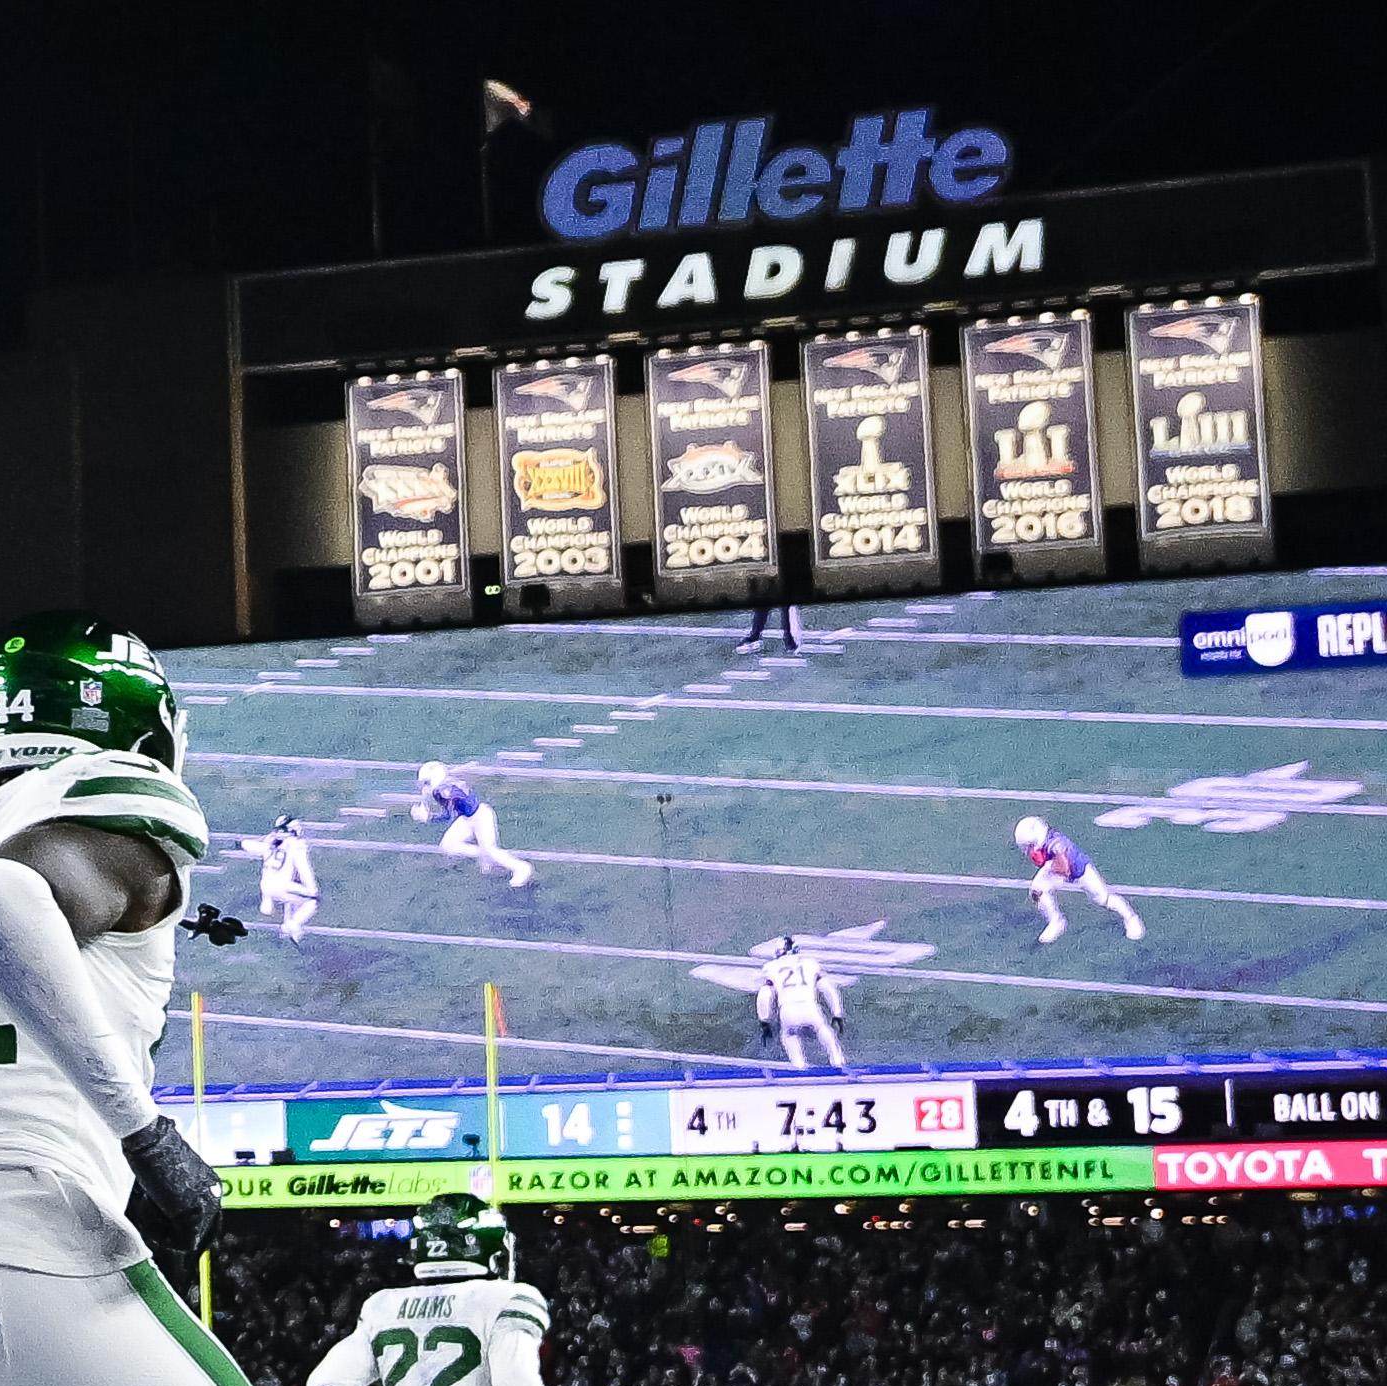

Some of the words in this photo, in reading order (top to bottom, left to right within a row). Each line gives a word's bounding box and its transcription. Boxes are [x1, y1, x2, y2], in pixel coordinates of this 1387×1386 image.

[542, 109, 1008, 240] Gillette
[525, 217, 1044, 320] STADIUM
[1000, 479, 1072, 500] WORLD
[1165, 463, 1242, 485] WORLD
[680, 503, 750, 526] WORLD
[838, 493, 910, 514] WORLD
[1155, 495, 1255, 529] 2018
[378, 529, 444, 548] WORLD
[527, 517, 593, 536] WORLD
[828, 525, 923, 558] 2014
[991, 512, 1087, 544] 2016
[514, 547, 609, 578] 2003
[666, 535, 766, 569] 2004
[369, 560, 457, 590] 2001
[9, 744, 77, 758] YORK
[686, 1105, 709, 1136] 4
[713, 1111, 738, 1131] TH
[776, 1099, 878, 1136] 7:43
[919, 1100, 961, 1130] 28
[1004, 1090, 1040, 1138] 4
[1045, 1099, 1078, 1129] TH
[1086, 1098, 1112, 1128] &
[1127, 1086, 1181, 1135] 15
[1273, 1092, 1338, 1123] BALL
[1340, 1090, 1381, 1121] ON
[309, 1100, 461, 1151] JETS
[541, 1103, 592, 1146] 14
[508, 1167, 610, 1192] RAZOR
[624, 1167, 658, 1188] AT
[671, 1157, 1115, 1189] AMAZON.COM/GILLETTENFL
[1157, 1149, 1335, 1185] TOYOTA
[425, 1239, 449, 1257] 22
[397, 1295, 457, 1320] ADAMS
